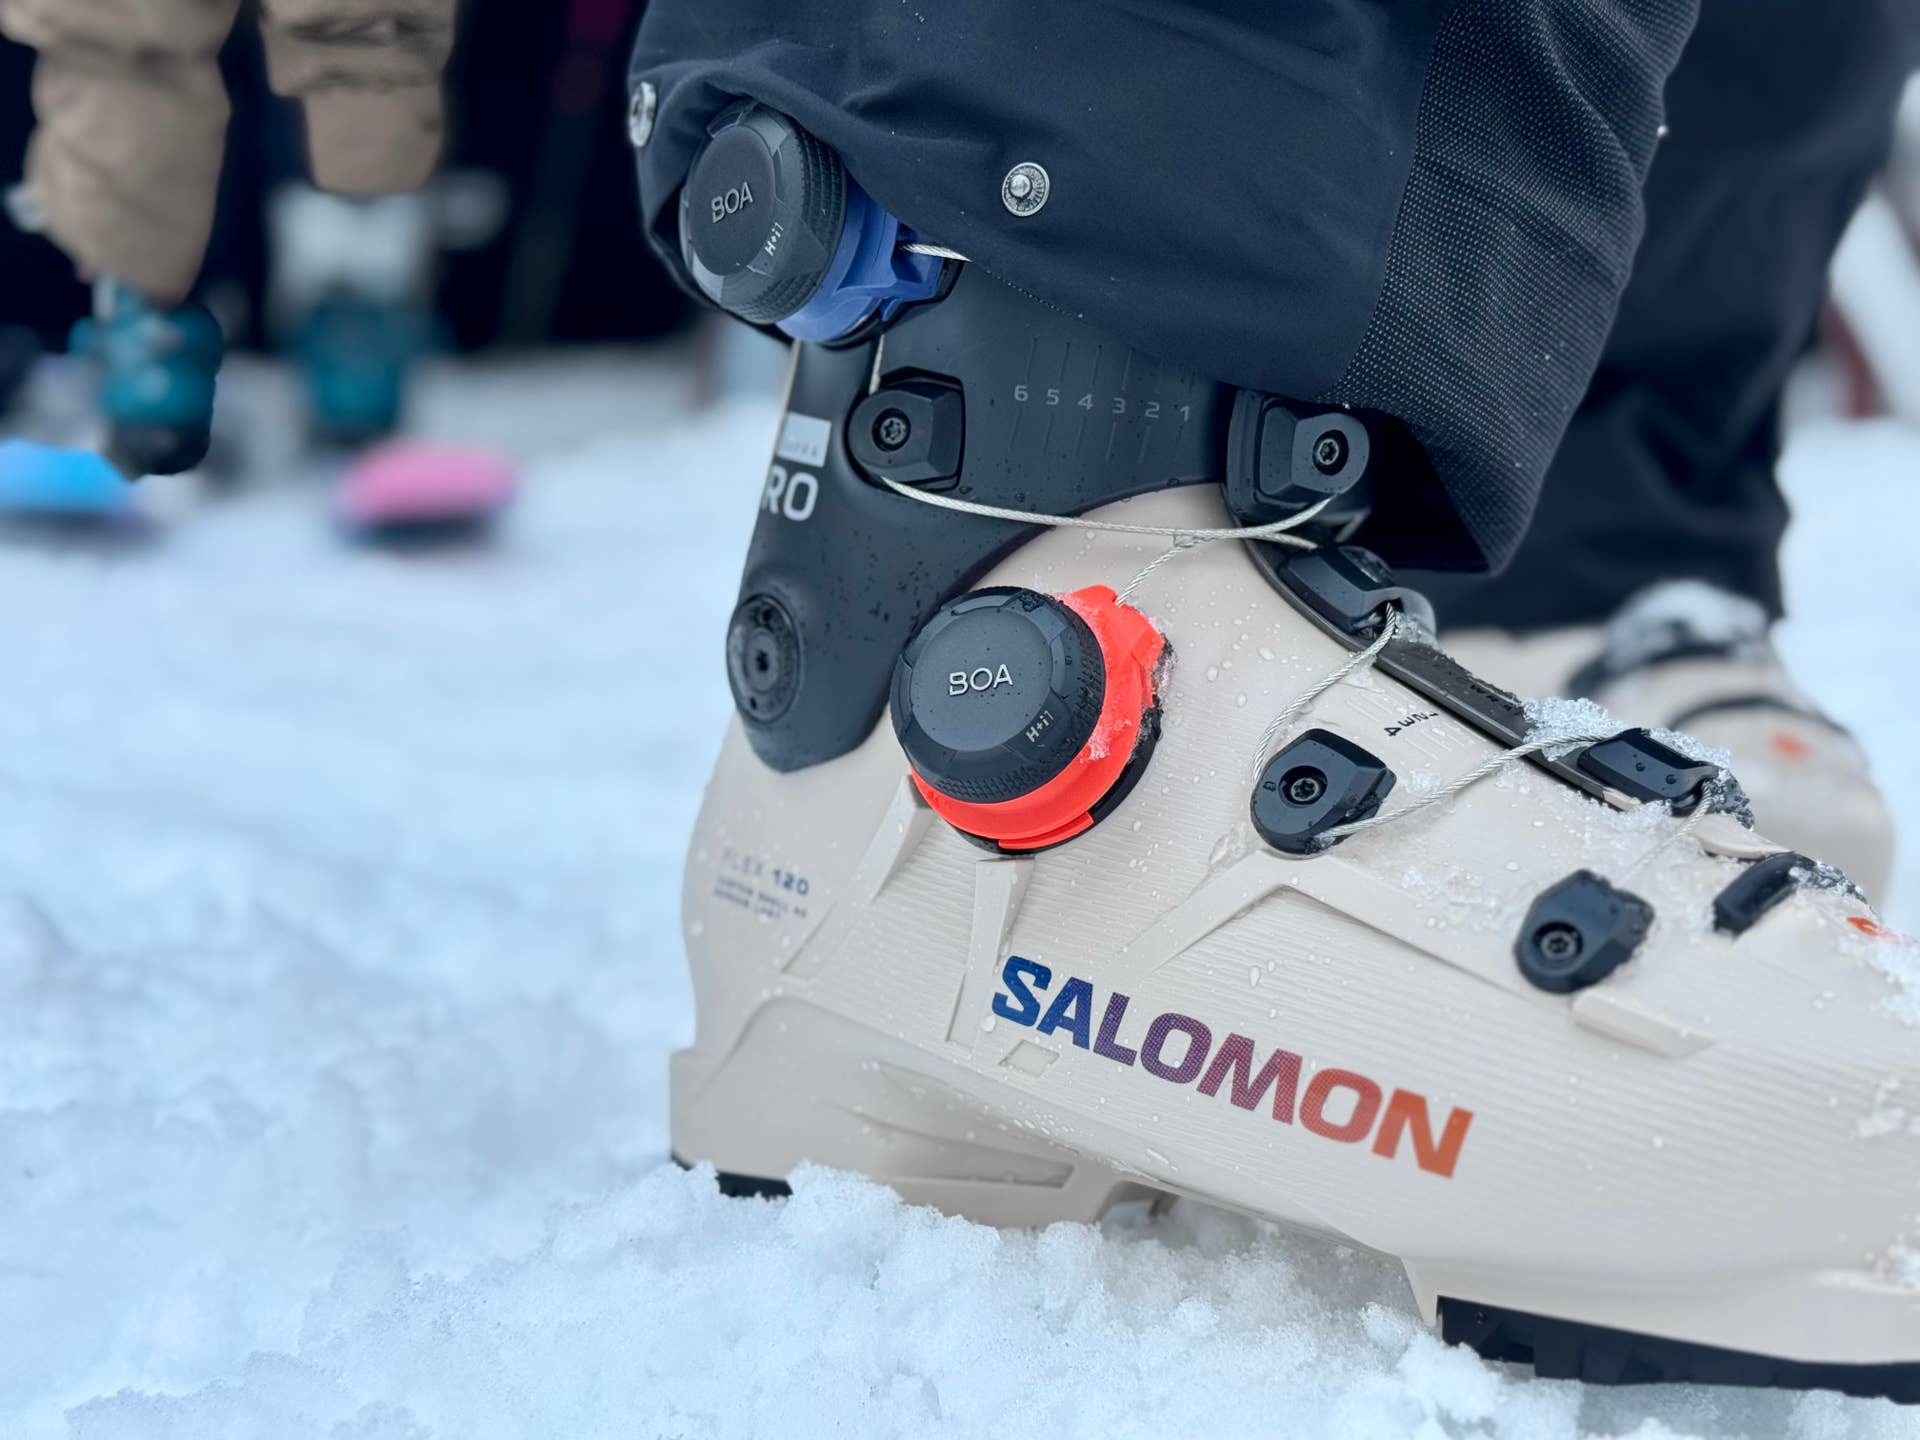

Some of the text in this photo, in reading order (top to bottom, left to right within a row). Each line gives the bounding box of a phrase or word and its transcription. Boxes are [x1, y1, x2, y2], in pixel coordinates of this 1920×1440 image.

[711, 181, 753, 223] BOA
[1013, 385, 1190, 422] 6 5 4 3 2 1
[949, 663, 1014, 696] BOA
[1383, 726, 1402, 737] 4
[773, 868, 810, 897] 120
[992, 955, 1475, 1180] SALOMON
